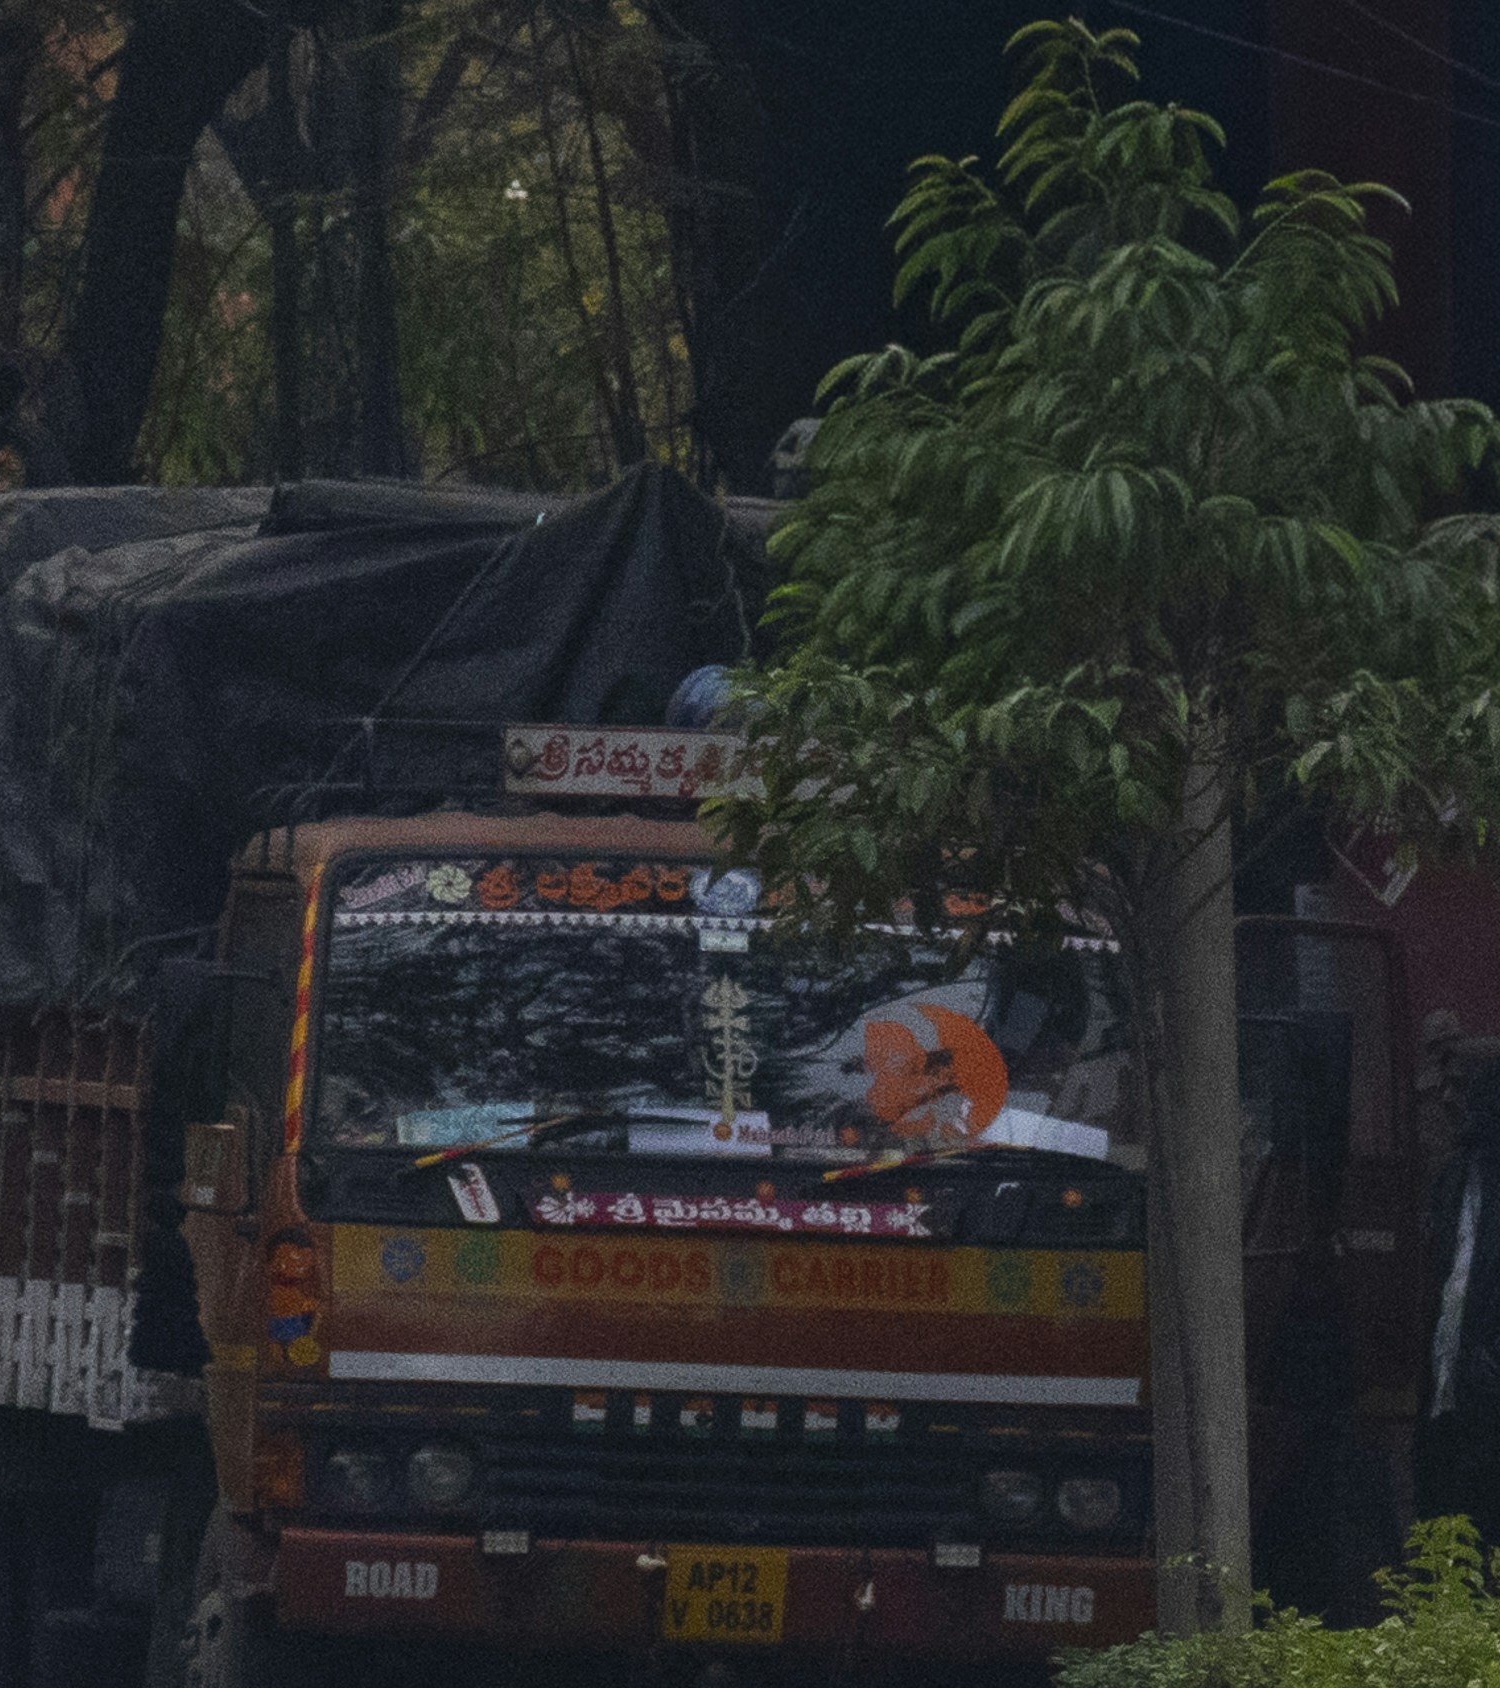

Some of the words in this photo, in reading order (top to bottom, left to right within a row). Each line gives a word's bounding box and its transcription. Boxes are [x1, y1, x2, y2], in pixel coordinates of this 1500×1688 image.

[530, 1244, 712, 1296] GOODS
[770, 1252, 951, 1305] CARRIER
[344, 1560, 438, 1600] ROAD
[1003, 1584, 1095, 1625] KING
[687, 1561, 759, 1593] AP12
